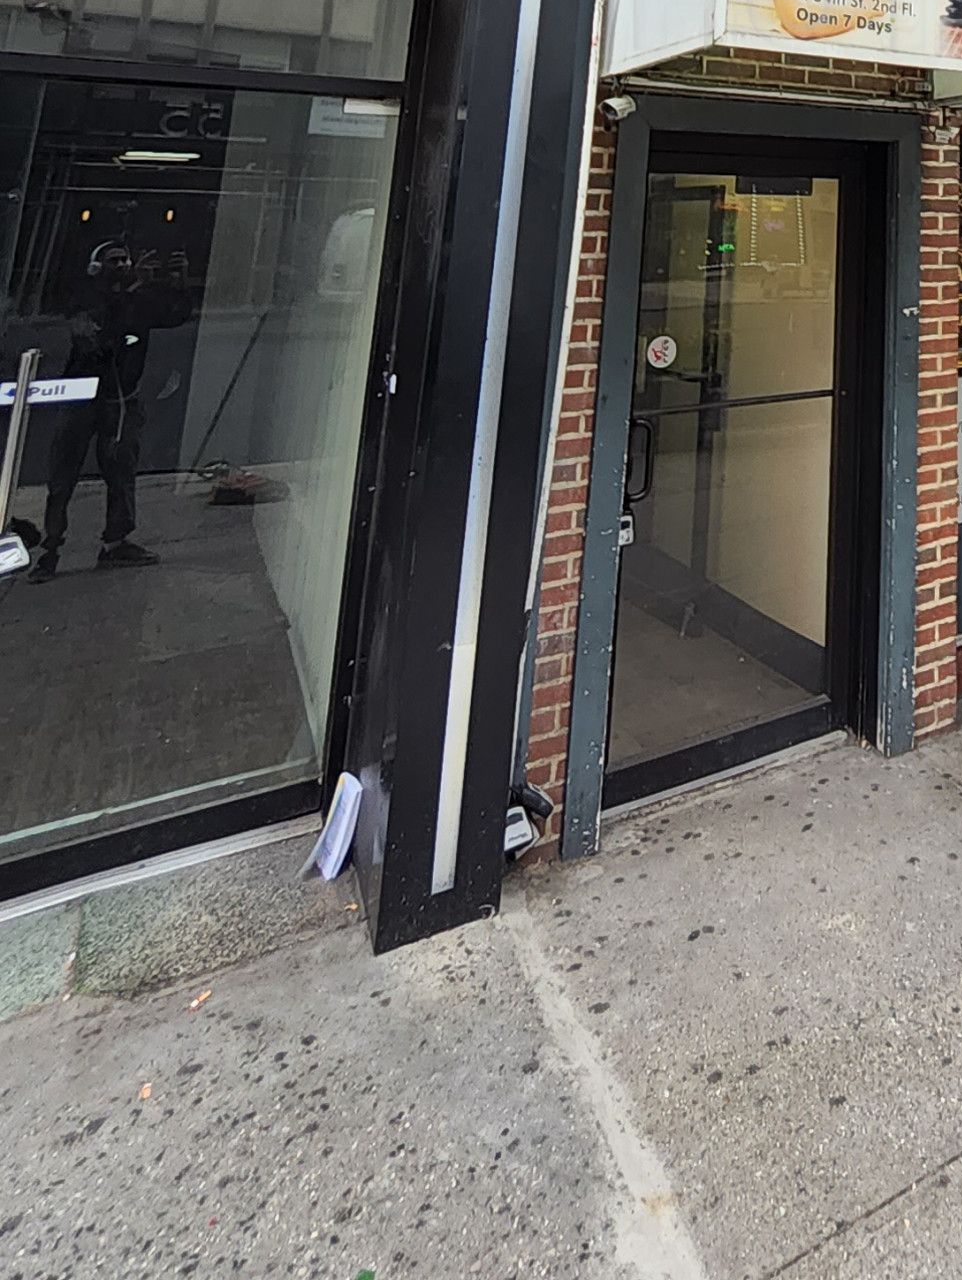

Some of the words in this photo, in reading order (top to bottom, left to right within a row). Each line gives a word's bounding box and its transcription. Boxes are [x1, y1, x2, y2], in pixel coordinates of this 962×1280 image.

[902, 3, 917, 17] Fl.
[796, 8, 838, 26] Open
[843, 14, 852, 27] 7
[857, 16, 893, 36] Days
[27, 384, 66, 398] Pull
